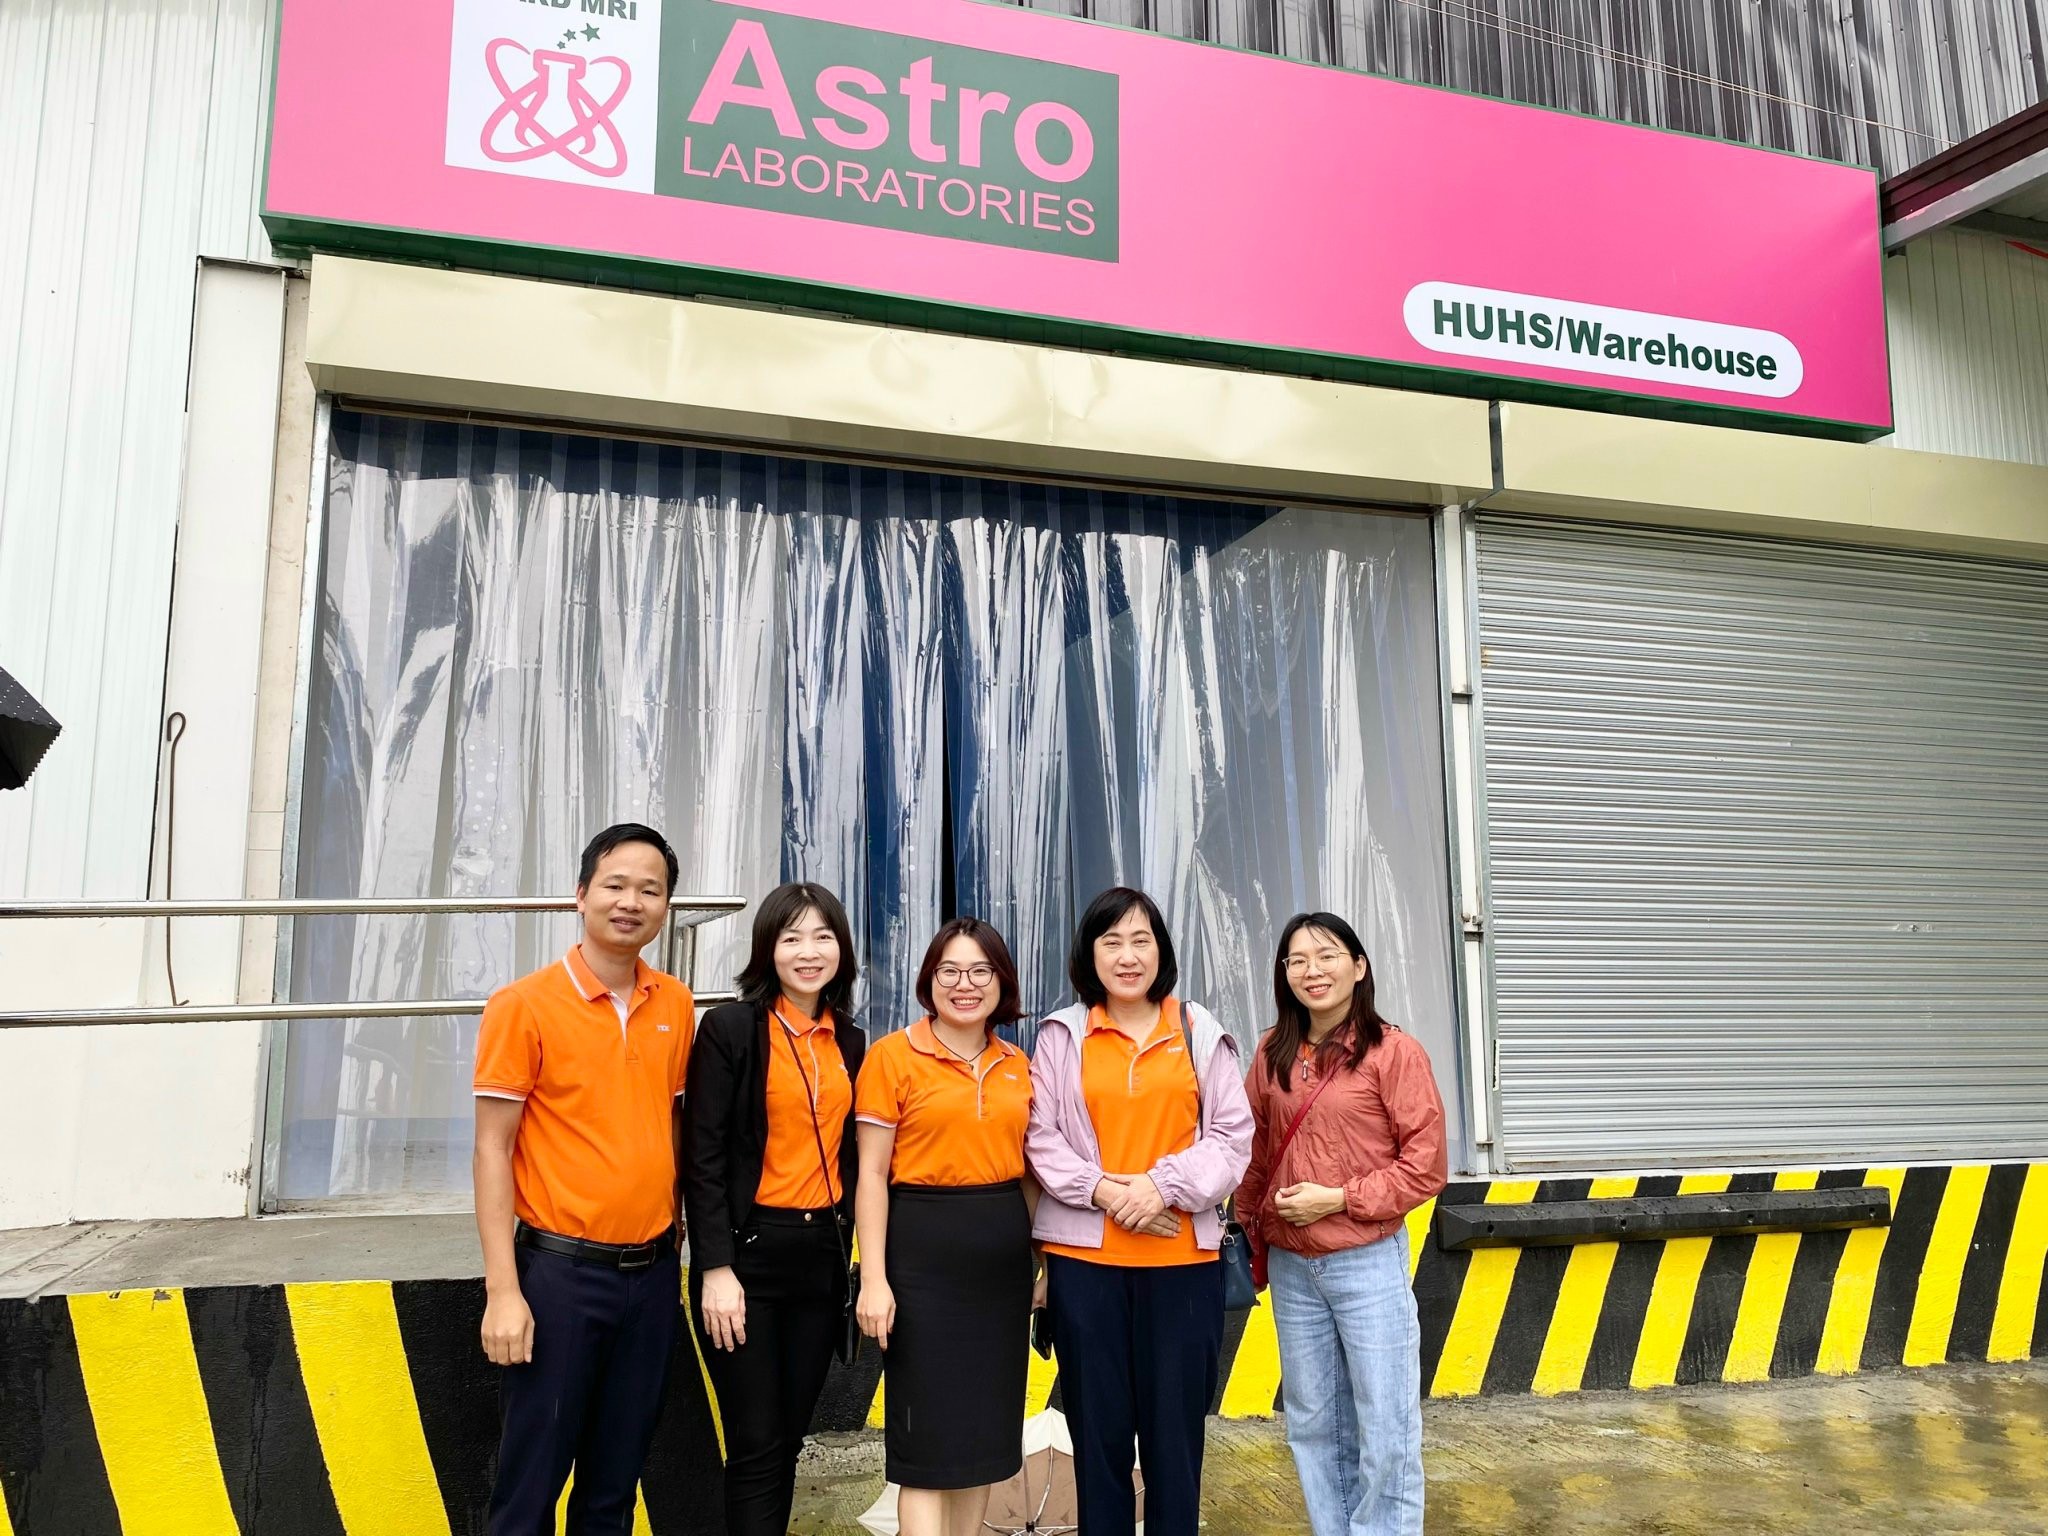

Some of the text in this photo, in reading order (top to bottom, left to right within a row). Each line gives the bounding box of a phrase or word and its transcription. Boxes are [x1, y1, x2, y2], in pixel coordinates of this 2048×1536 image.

[580, 0, 637, 20] MRI
[687, 18, 1094, 183] Astro
[682, 137, 1096, 236] LABORATORIES
[1433, 299, 1778, 380] HUHS/Warehouse
